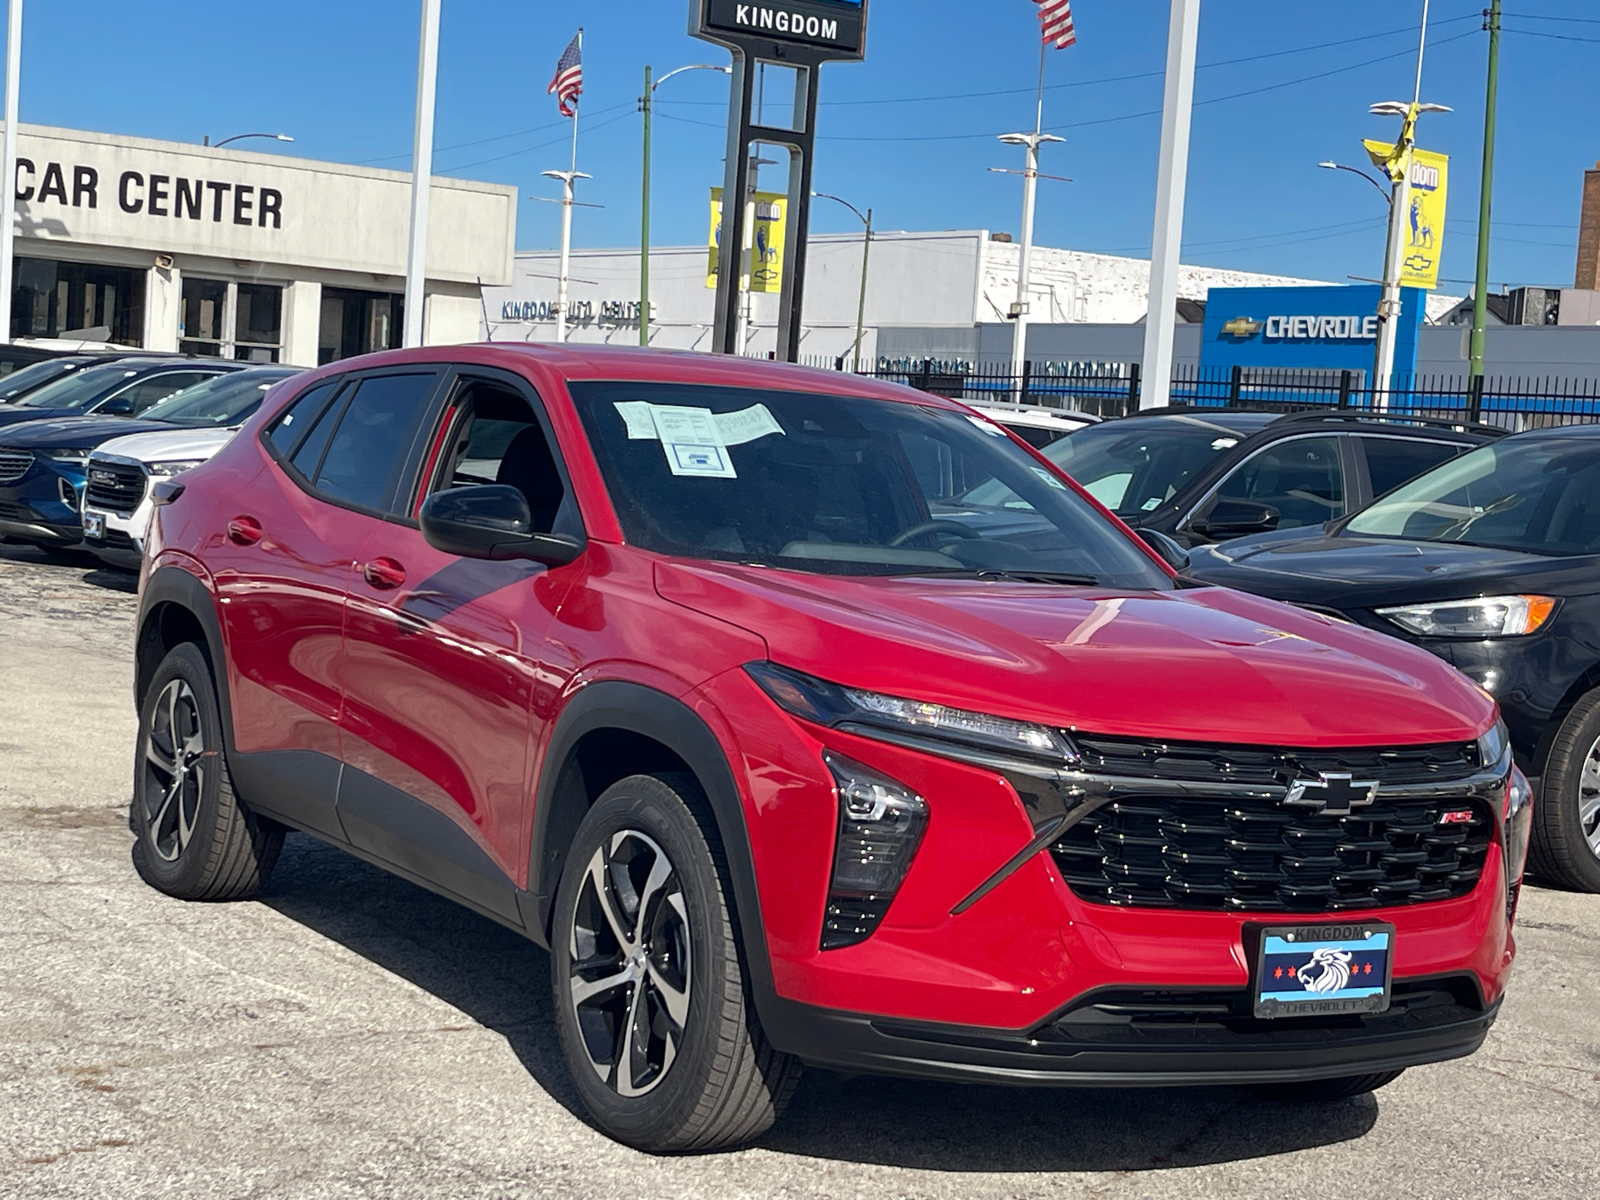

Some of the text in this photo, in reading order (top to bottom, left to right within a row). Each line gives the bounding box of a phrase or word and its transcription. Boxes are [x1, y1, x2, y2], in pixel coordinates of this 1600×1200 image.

[736, 4, 838, 40] KINGDOM
[1411, 160, 1439, 191] dom
[15, 157, 283, 230] CAR CENTER
[566, 300, 594, 320] UTO
[601, 300, 653, 320] CENTE
[1265, 315, 1378, 339] CHEVROLE
[1439, 810, 1474, 824] RS
[1295, 926, 1366, 941] KINGDOM
[1286, 1000, 1358, 1014] CHEVROLET
